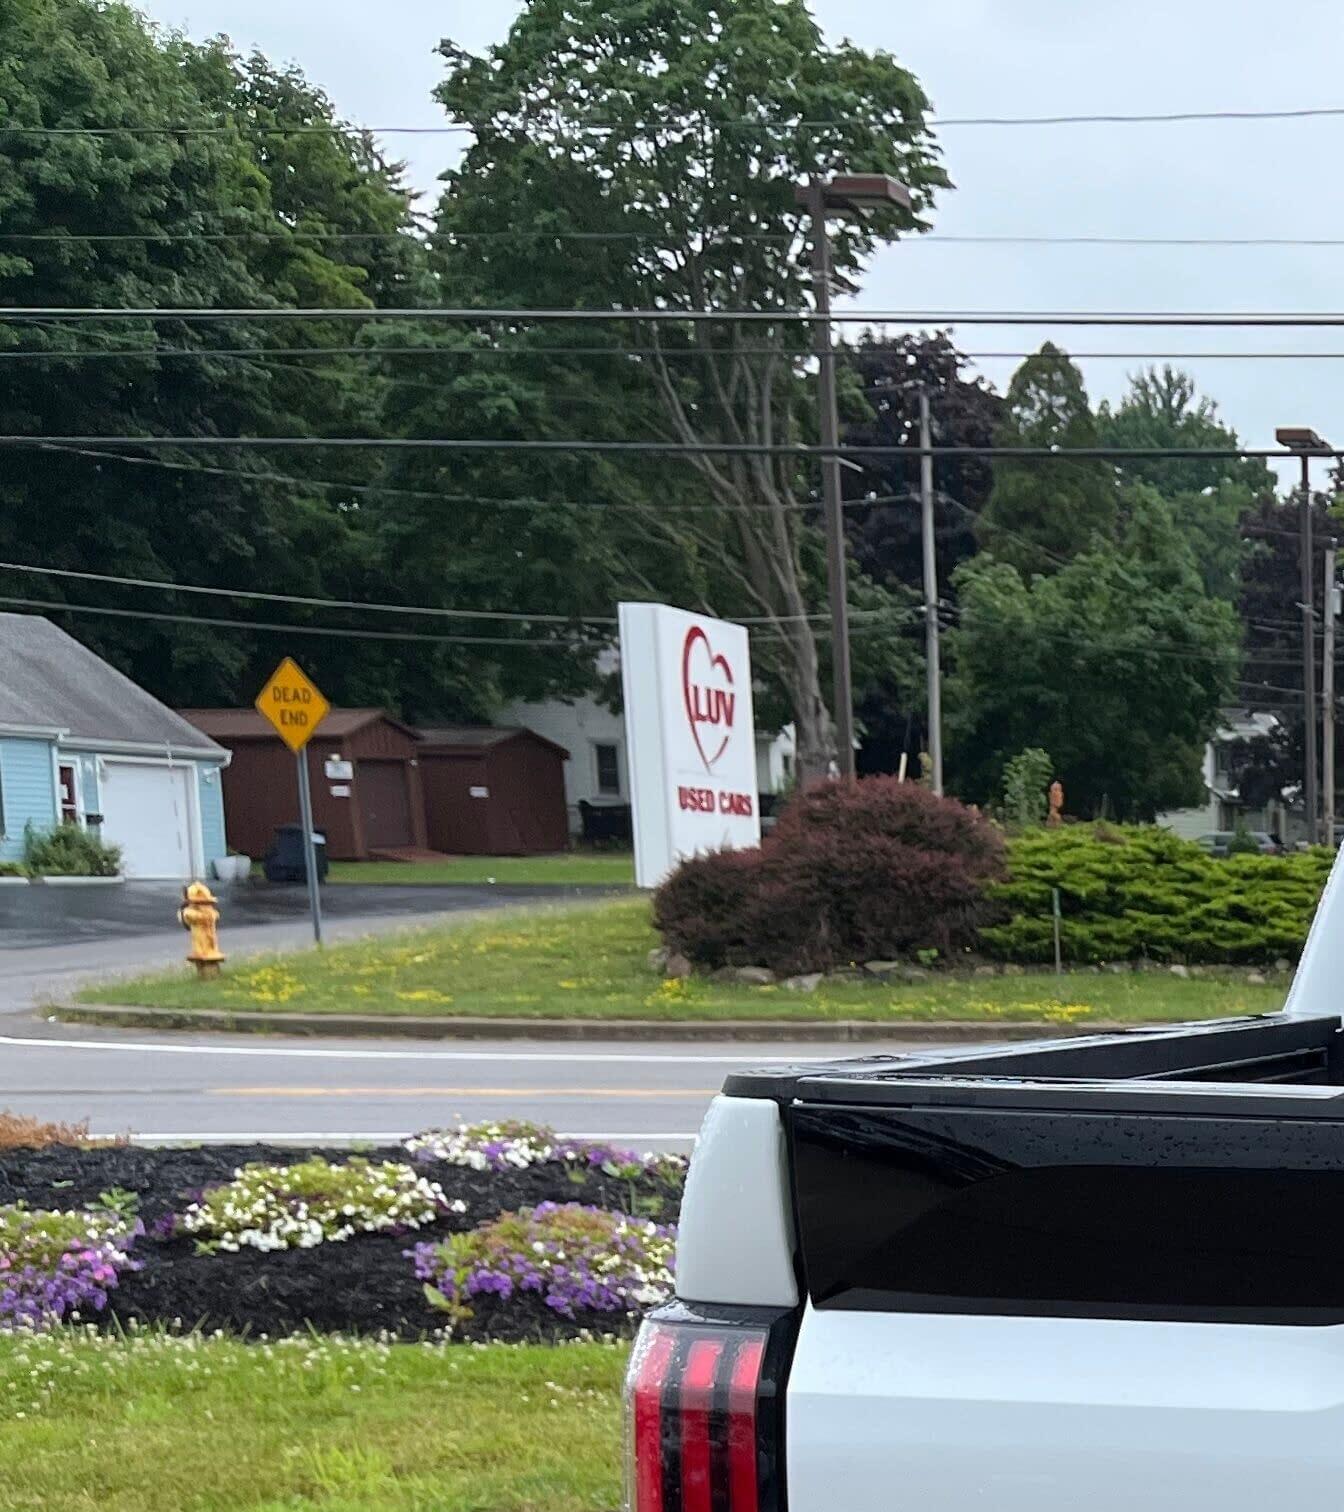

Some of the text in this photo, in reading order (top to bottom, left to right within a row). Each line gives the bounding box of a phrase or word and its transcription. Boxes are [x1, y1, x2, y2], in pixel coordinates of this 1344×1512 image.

[272, 686, 312, 704] DEAD
[691, 685, 735, 727] LUV
[280, 708, 308, 726] END
[677, 785, 752, 817] USED CARS
